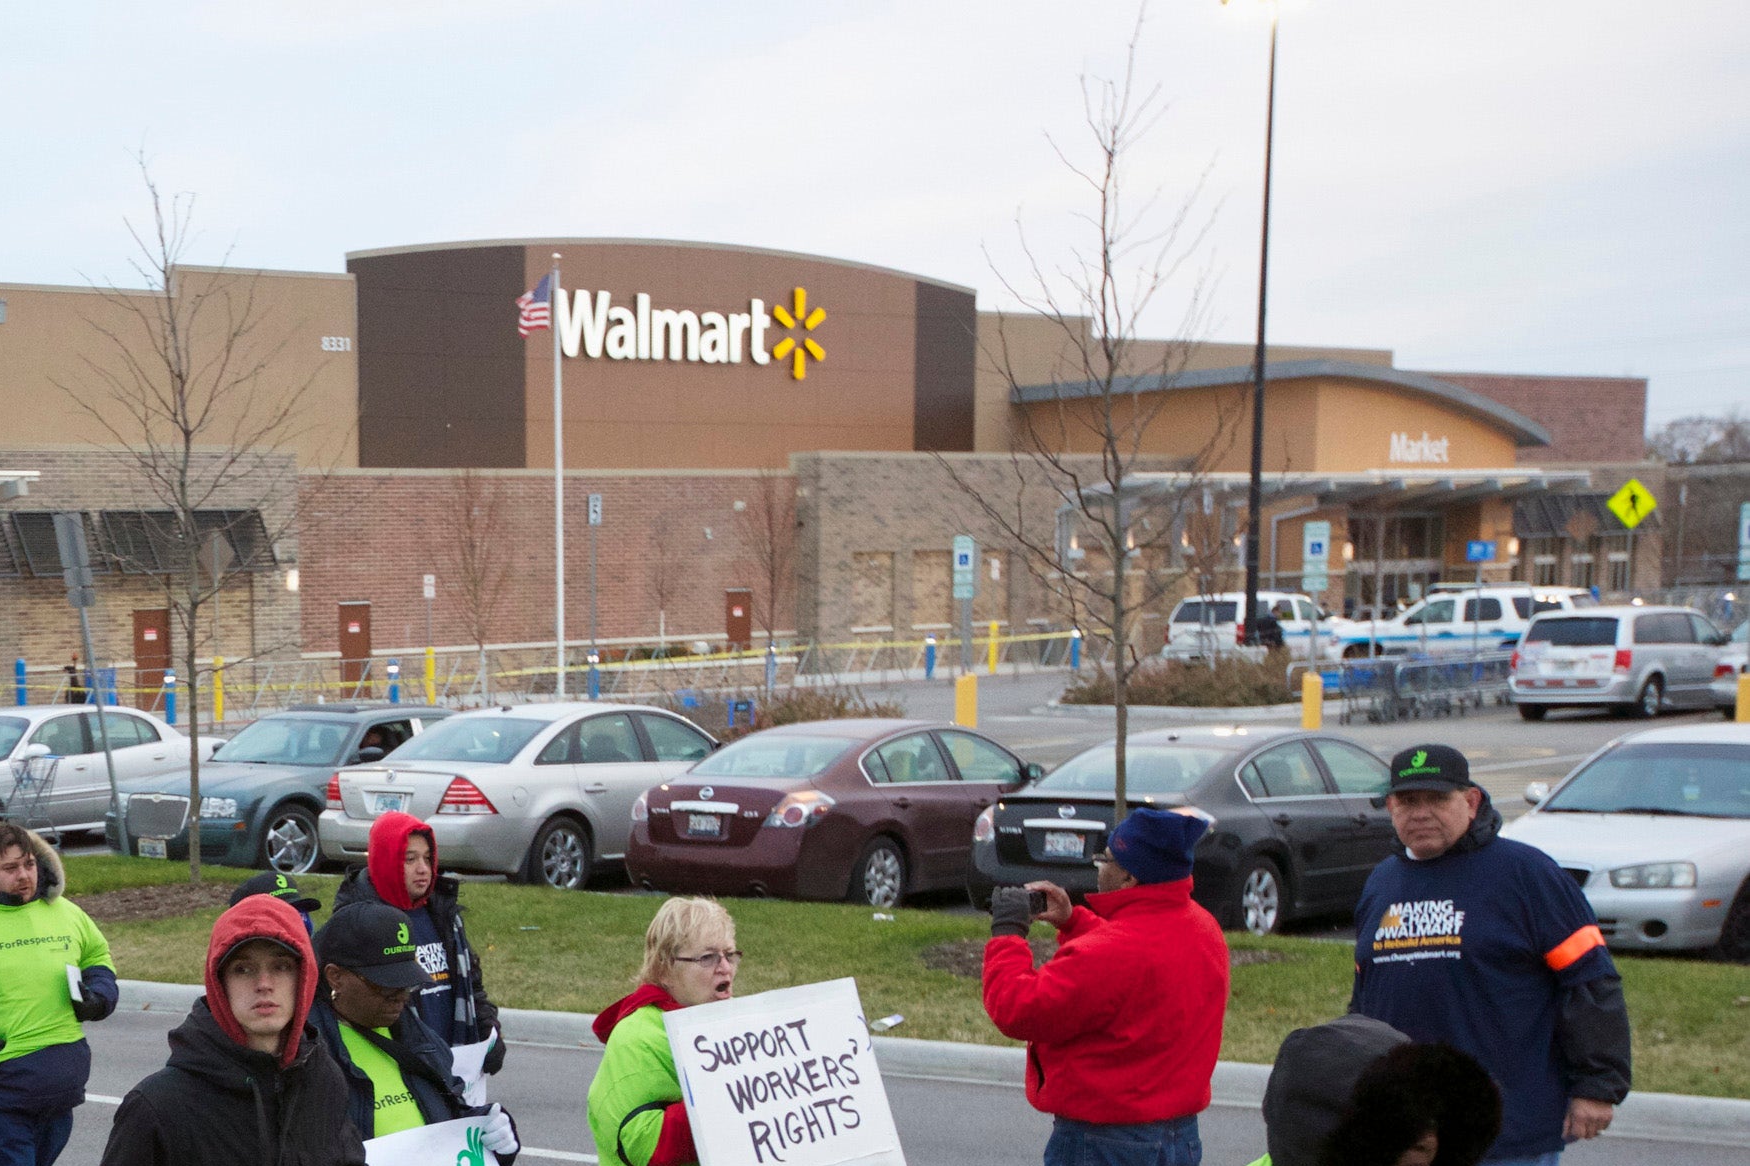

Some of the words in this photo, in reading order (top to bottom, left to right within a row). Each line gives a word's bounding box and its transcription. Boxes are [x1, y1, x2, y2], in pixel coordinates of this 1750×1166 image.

[557, 288, 770, 365] Walmart
[321, 336, 352, 351] 8331
[1389, 431, 1449, 463] Market
[1389, 900, 1454, 917] MAKING
[1399, 911, 1465, 927] CHANGE
[693, 1018, 811, 1072] SUPPORT
[748, 1095, 862, 1164] RIGHTS
